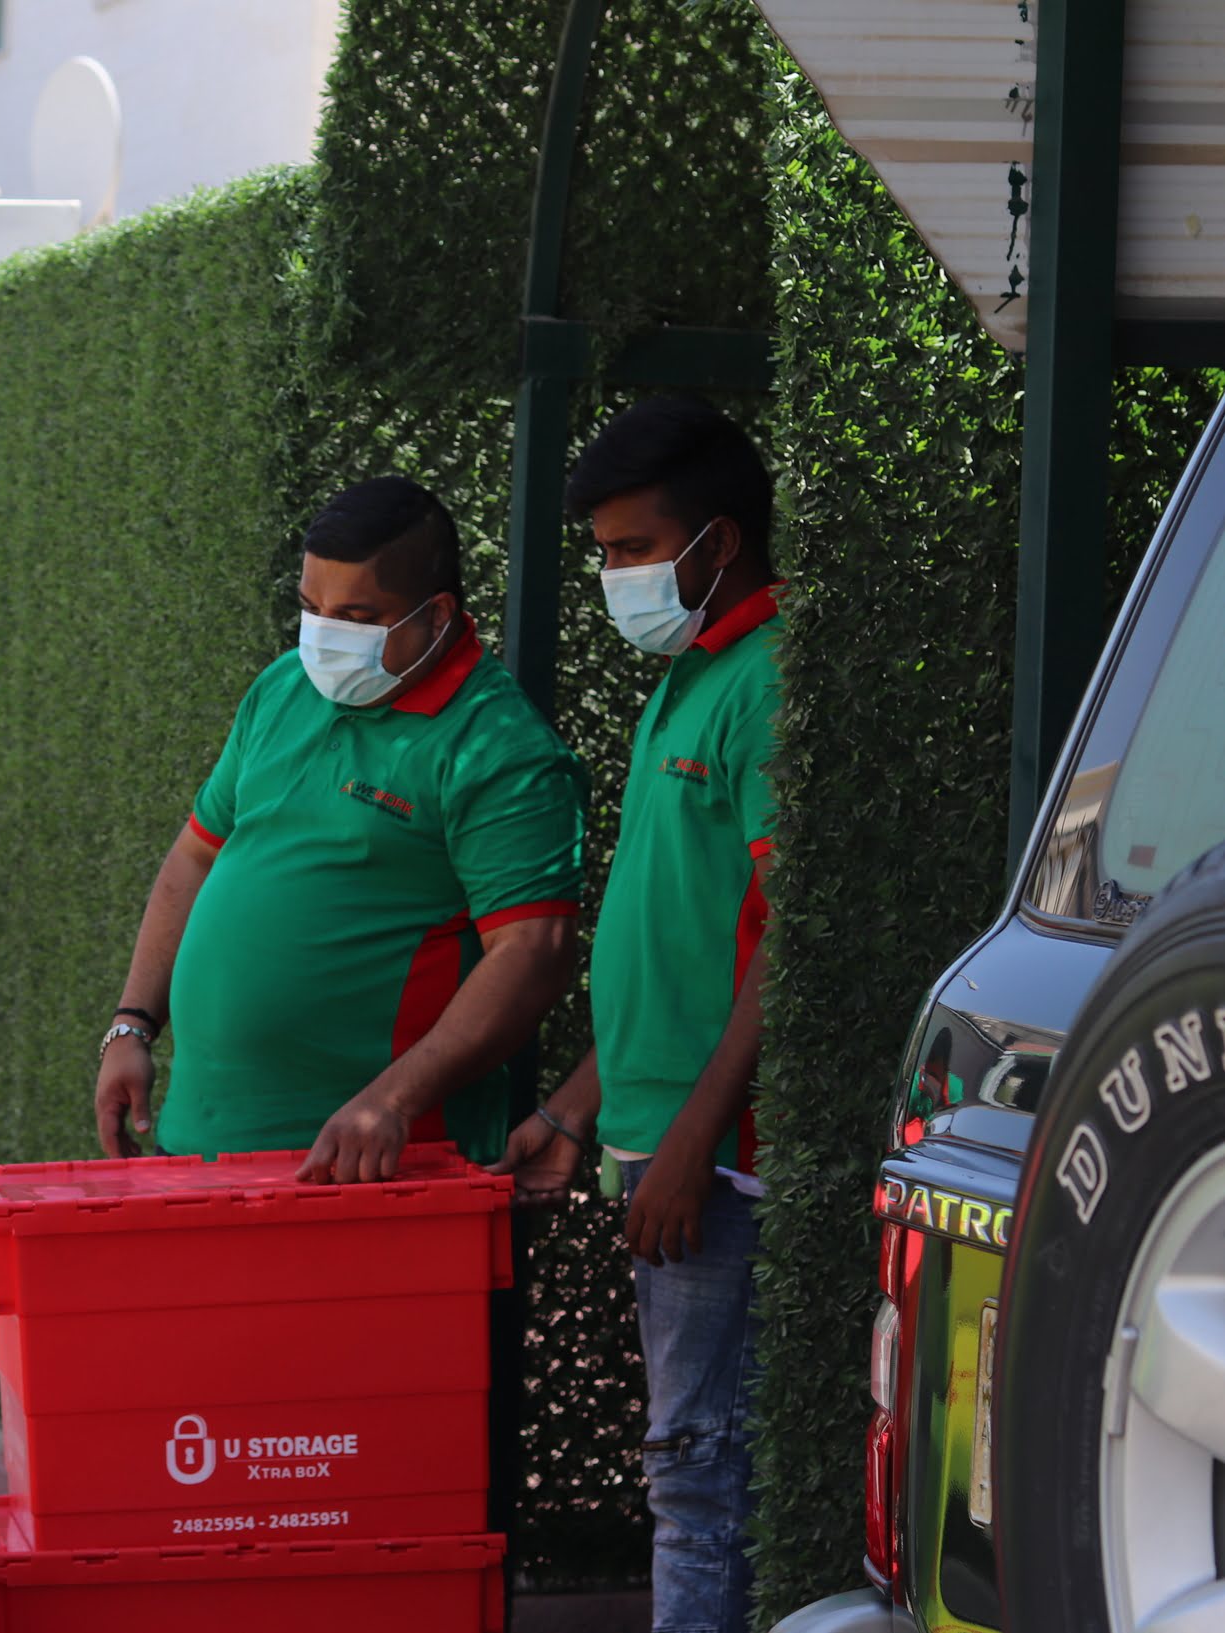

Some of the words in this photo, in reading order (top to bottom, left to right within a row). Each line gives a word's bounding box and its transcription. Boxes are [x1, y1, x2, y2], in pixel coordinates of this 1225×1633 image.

[1056, 1009, 1225, 1224] DUN
[224, 1439, 241, 1459] U
[248, 1434, 358, 1458] STORAGE
[247, 1465, 292, 1480] XTRA
[173, 1516, 255, 1534] 24825954
[269, 1511, 349, 1529] 24825951
